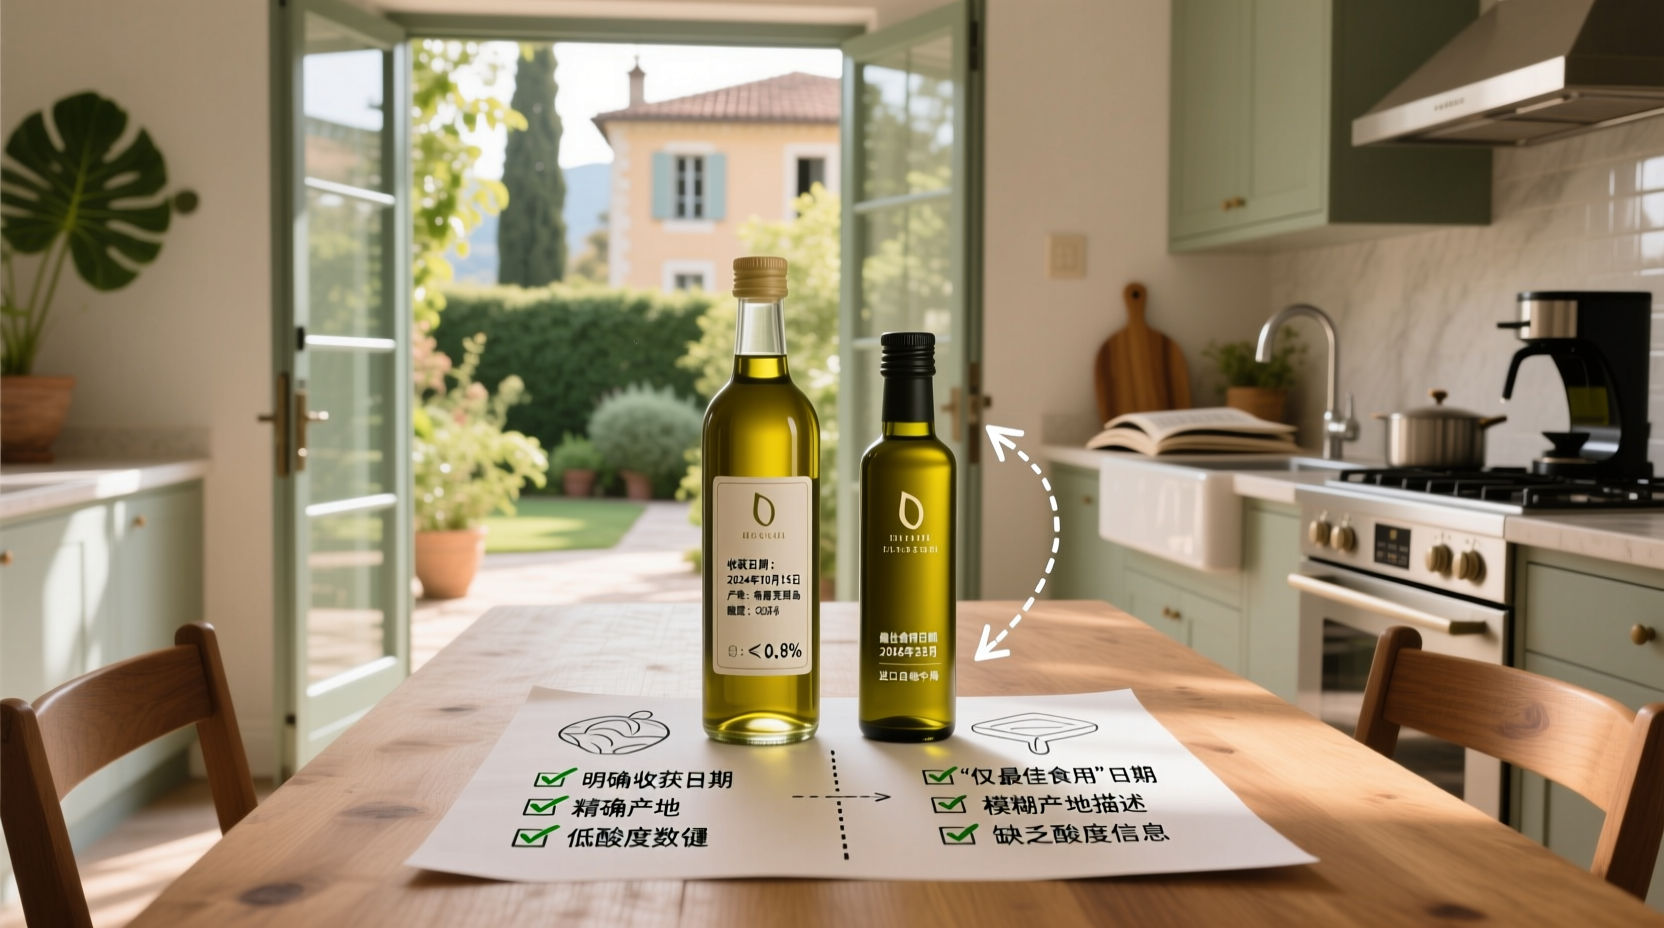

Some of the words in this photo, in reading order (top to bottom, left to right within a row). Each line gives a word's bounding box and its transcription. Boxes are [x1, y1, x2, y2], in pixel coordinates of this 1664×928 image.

[582, 769, 733, 790] 明确收获日期
[960, 765, 1158, 786] “仅最佳食用”日期
[571, 797, 681, 818] 精确产地
[982, 793, 1148, 816] 模糊产地描述
[992, 822, 1171, 846] 缺乏酸度信息
